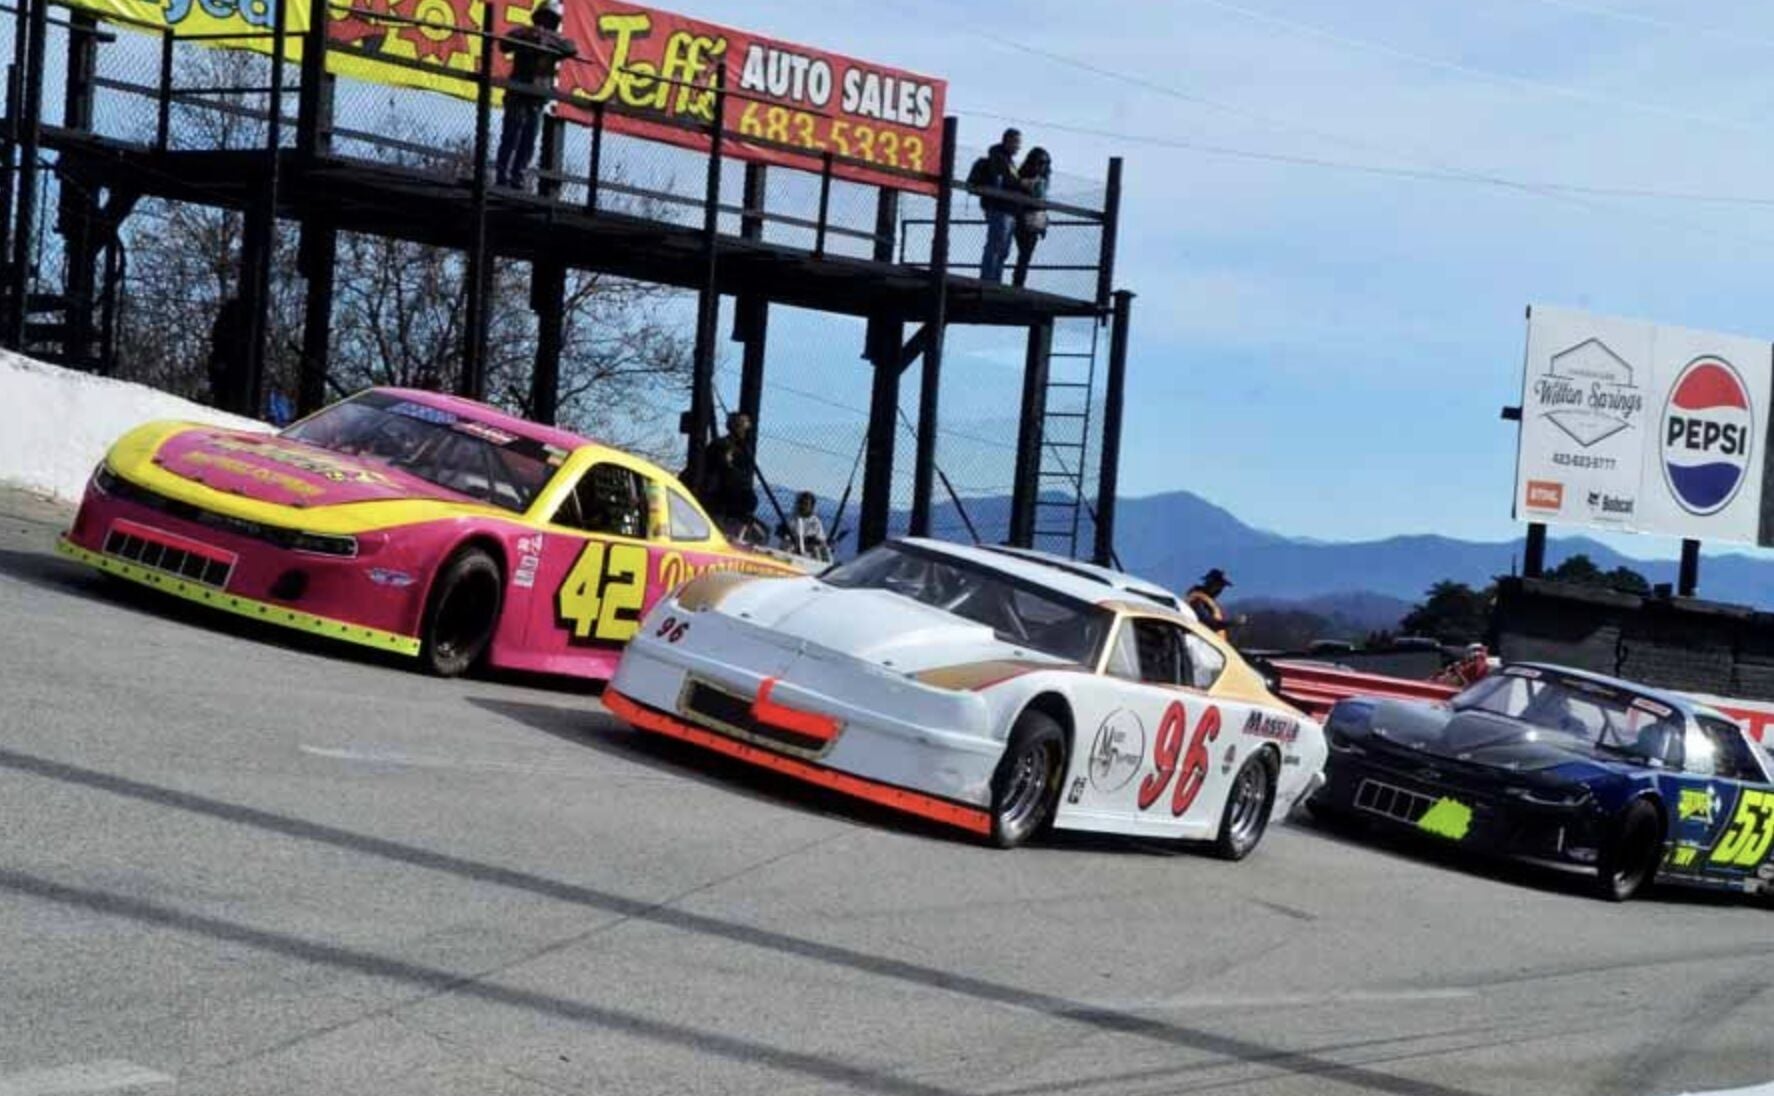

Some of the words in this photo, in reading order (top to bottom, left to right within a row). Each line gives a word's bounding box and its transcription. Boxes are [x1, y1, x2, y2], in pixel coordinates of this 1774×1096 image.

[740, 43, 832, 107] AUTO
[841, 67, 933, 129] SALES
[738, 100, 925, 172] 683-5333
[1666, 416, 1748, 456] PEPSI
[557, 539, 649, 643] 42
[655, 616, 690, 643] 96
[1137, 698, 1222, 818] 96
[1710, 788, 1774, 868] 53
